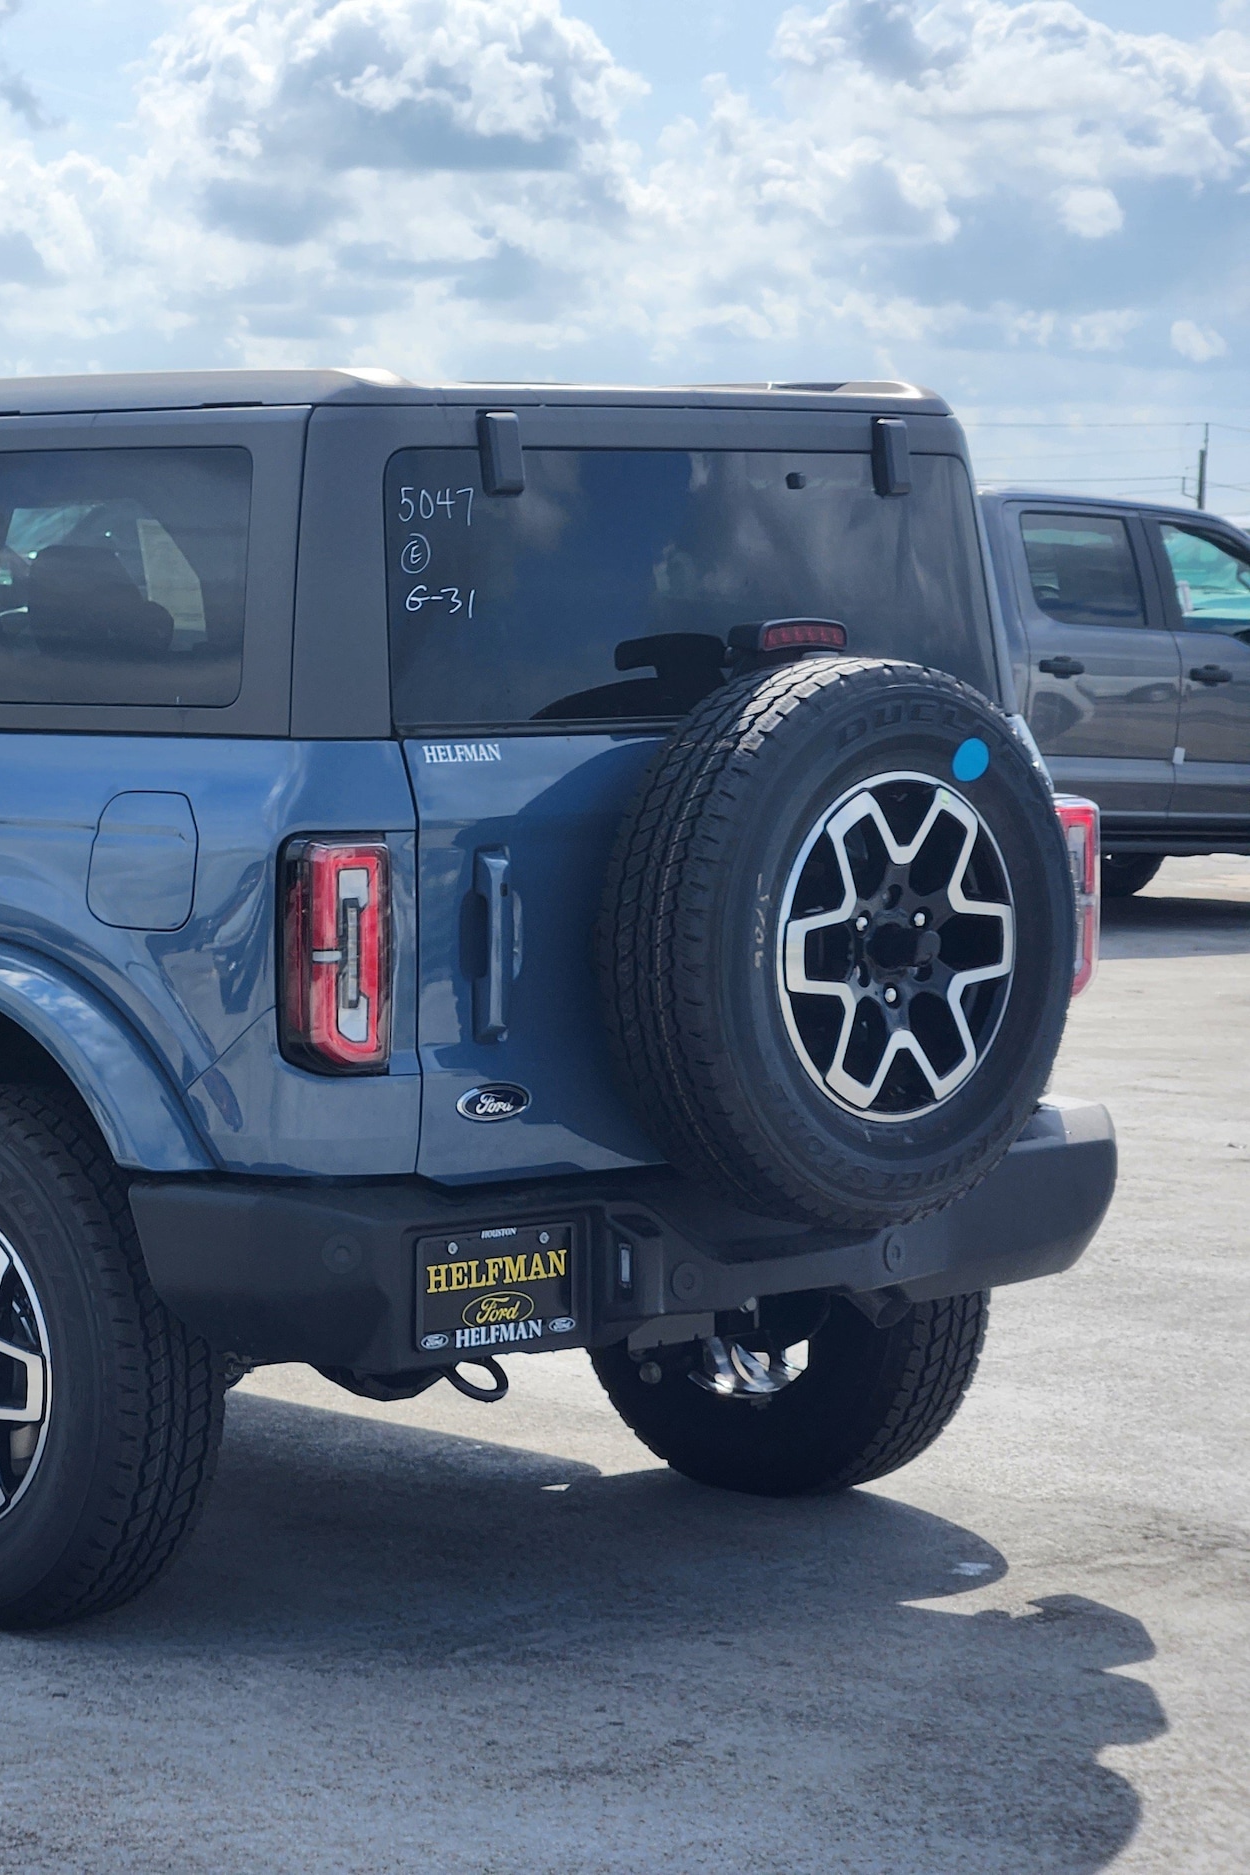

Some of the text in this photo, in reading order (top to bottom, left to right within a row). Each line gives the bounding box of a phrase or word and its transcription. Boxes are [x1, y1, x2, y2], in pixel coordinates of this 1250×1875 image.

[398, 487, 474, 526] 5047
[421, 743, 502, 764] HELFMAN
[475, 1092, 514, 1114] Ford
[481, 1227, 517, 1240] HOUSTON
[426, 1249, 567, 1294] HELFMAN
[475, 1296, 521, 1325] Ford
[455, 1319, 543, 1349] HELFMAN
